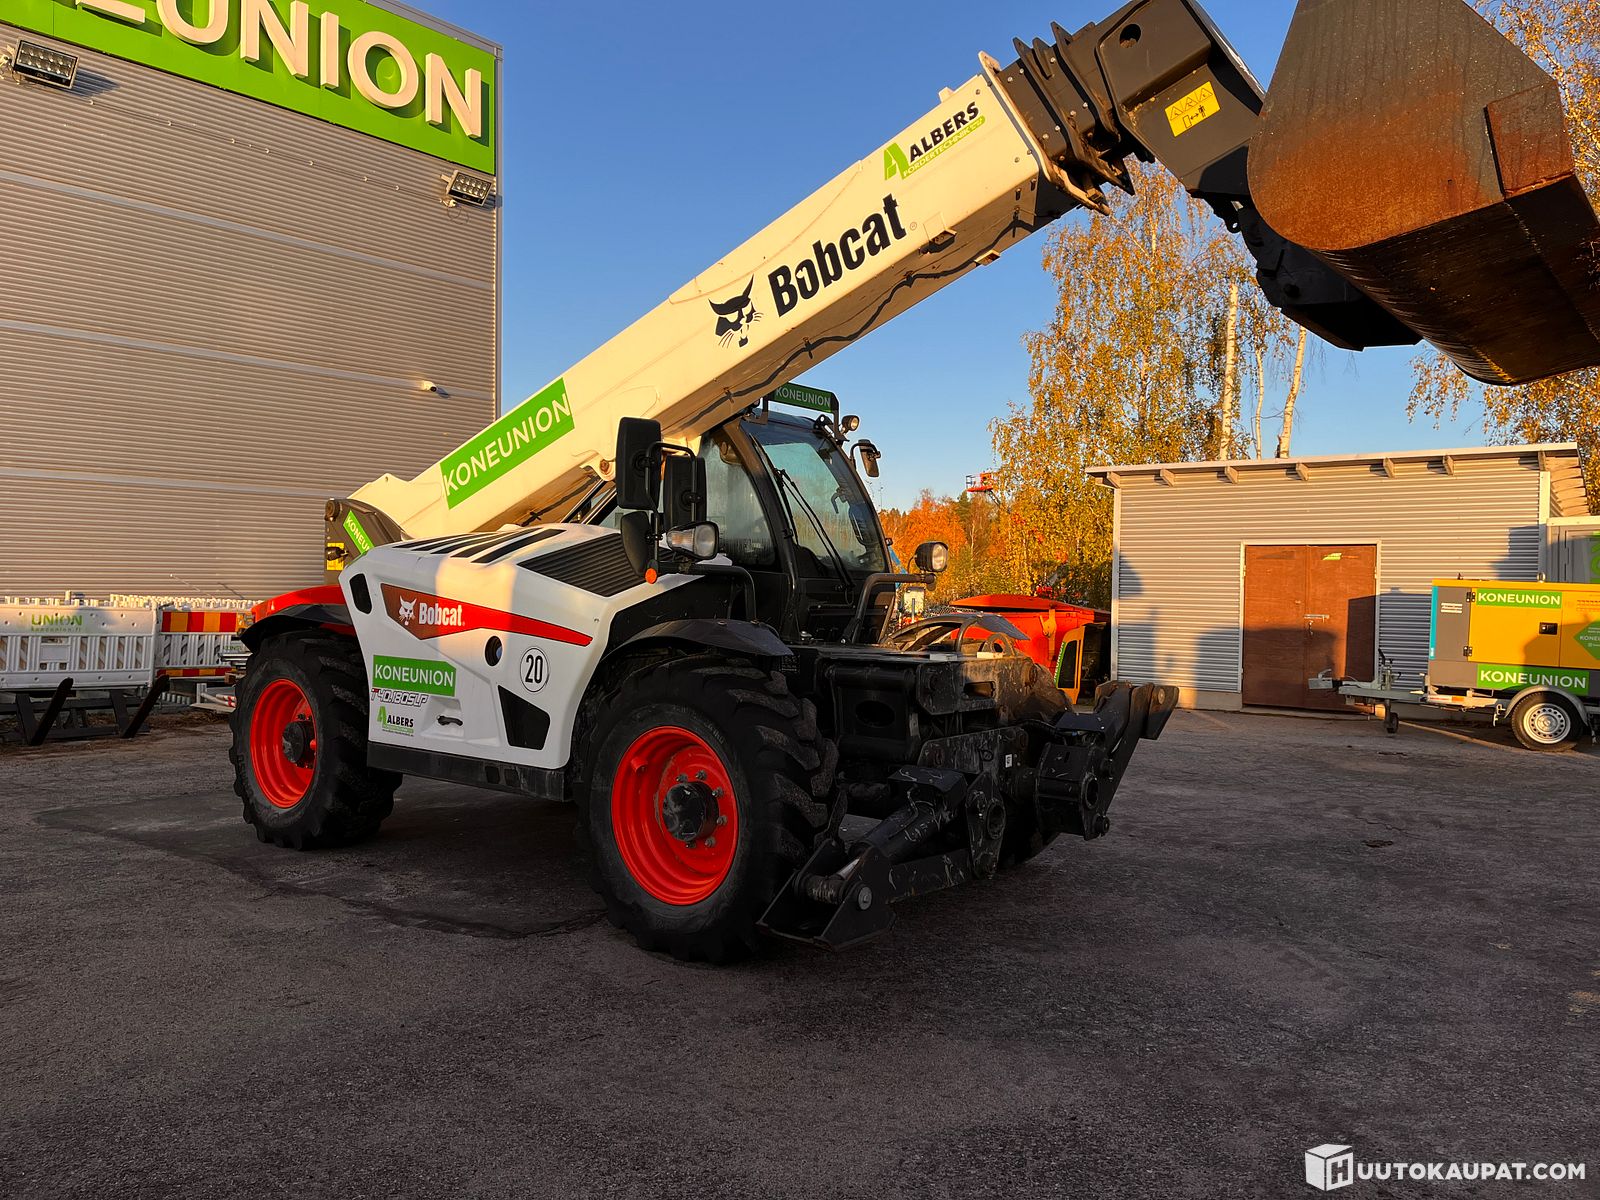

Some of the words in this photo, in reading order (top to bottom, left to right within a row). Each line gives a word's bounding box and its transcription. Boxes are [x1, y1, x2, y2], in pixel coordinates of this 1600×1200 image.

[910, 101, 979, 162] ALBERS
[768, 194, 906, 317] Bobcat
[775, 387, 831, 407] KONEUNION
[443, 393, 571, 496] KONEUNION
[1478, 592, 1561, 605] KONEUNION
[418, 603, 463, 626] Bobcat
[375, 664, 454, 688] KONEUNION
[525, 655, 543, 683] 20
[1480, 670, 1587, 689] KONEUNION
[387, 715, 414, 727] ALBERS
